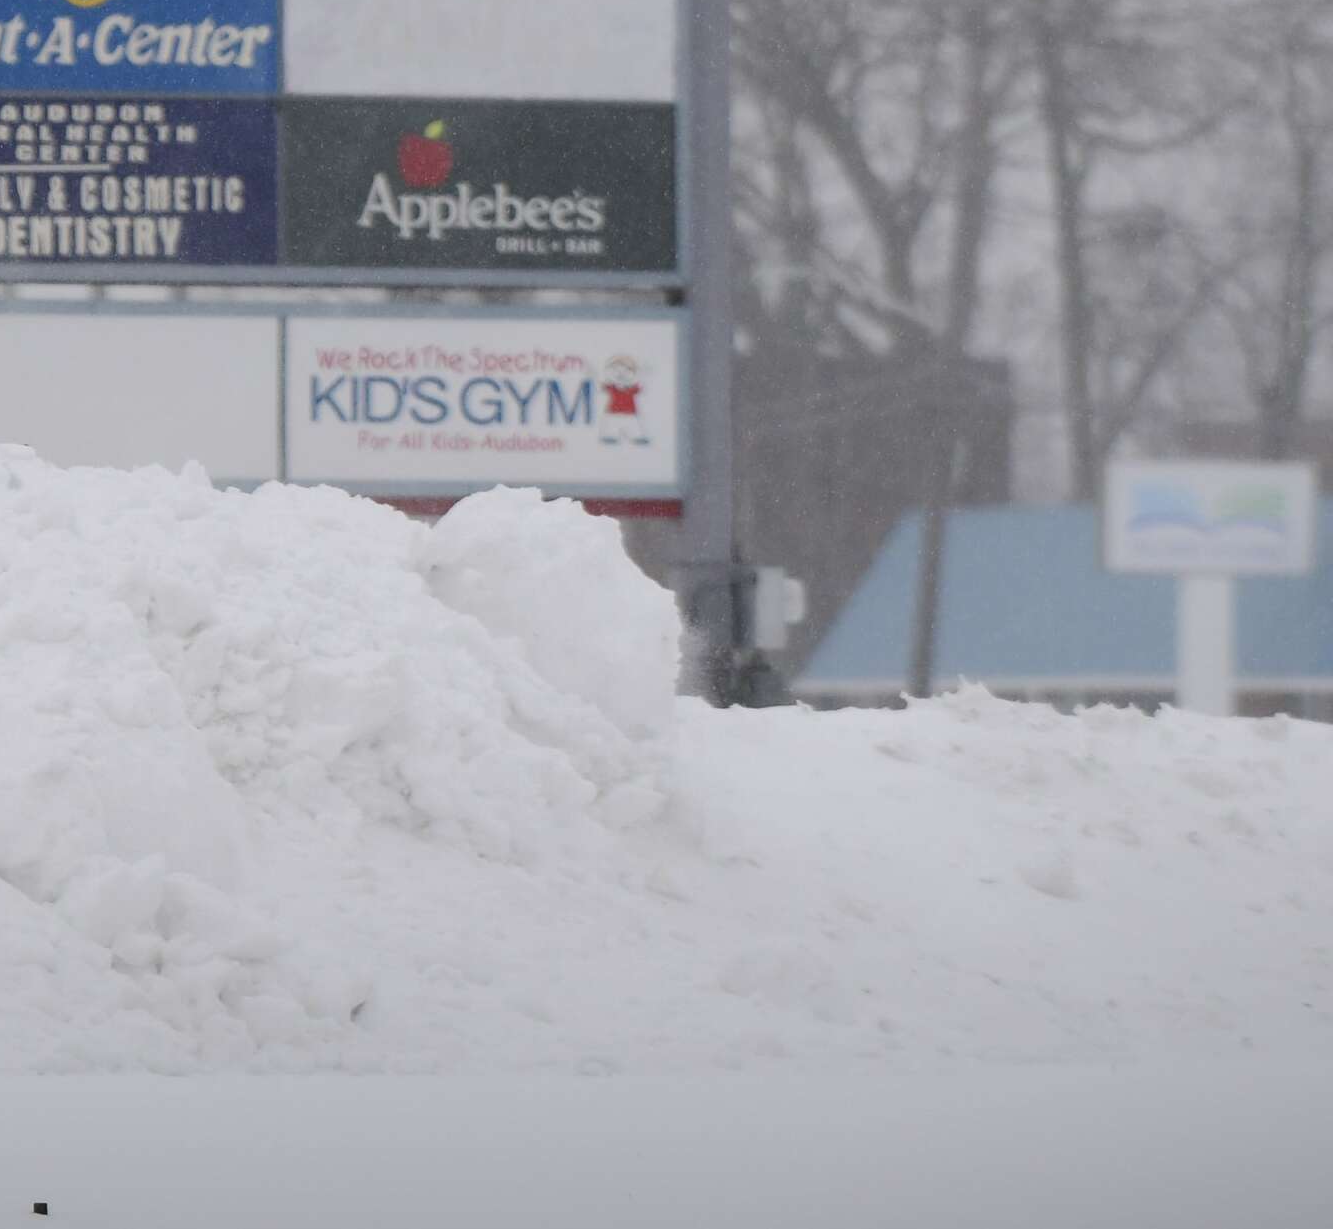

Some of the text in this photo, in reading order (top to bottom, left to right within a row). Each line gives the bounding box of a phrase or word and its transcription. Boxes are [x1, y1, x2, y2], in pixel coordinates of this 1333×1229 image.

[64, 124, 198, 145] HEALTH
[46, 175, 69, 213] &
[79, 175, 246, 213] COSMETIC
[355, 171, 607, 241] Applebee's
[315, 345, 585, 376] We Rock The Spectrum
[309, 374, 595, 426] KID'S GYM
[356, 430, 392, 451] For
[397, 430, 425, 451] All
